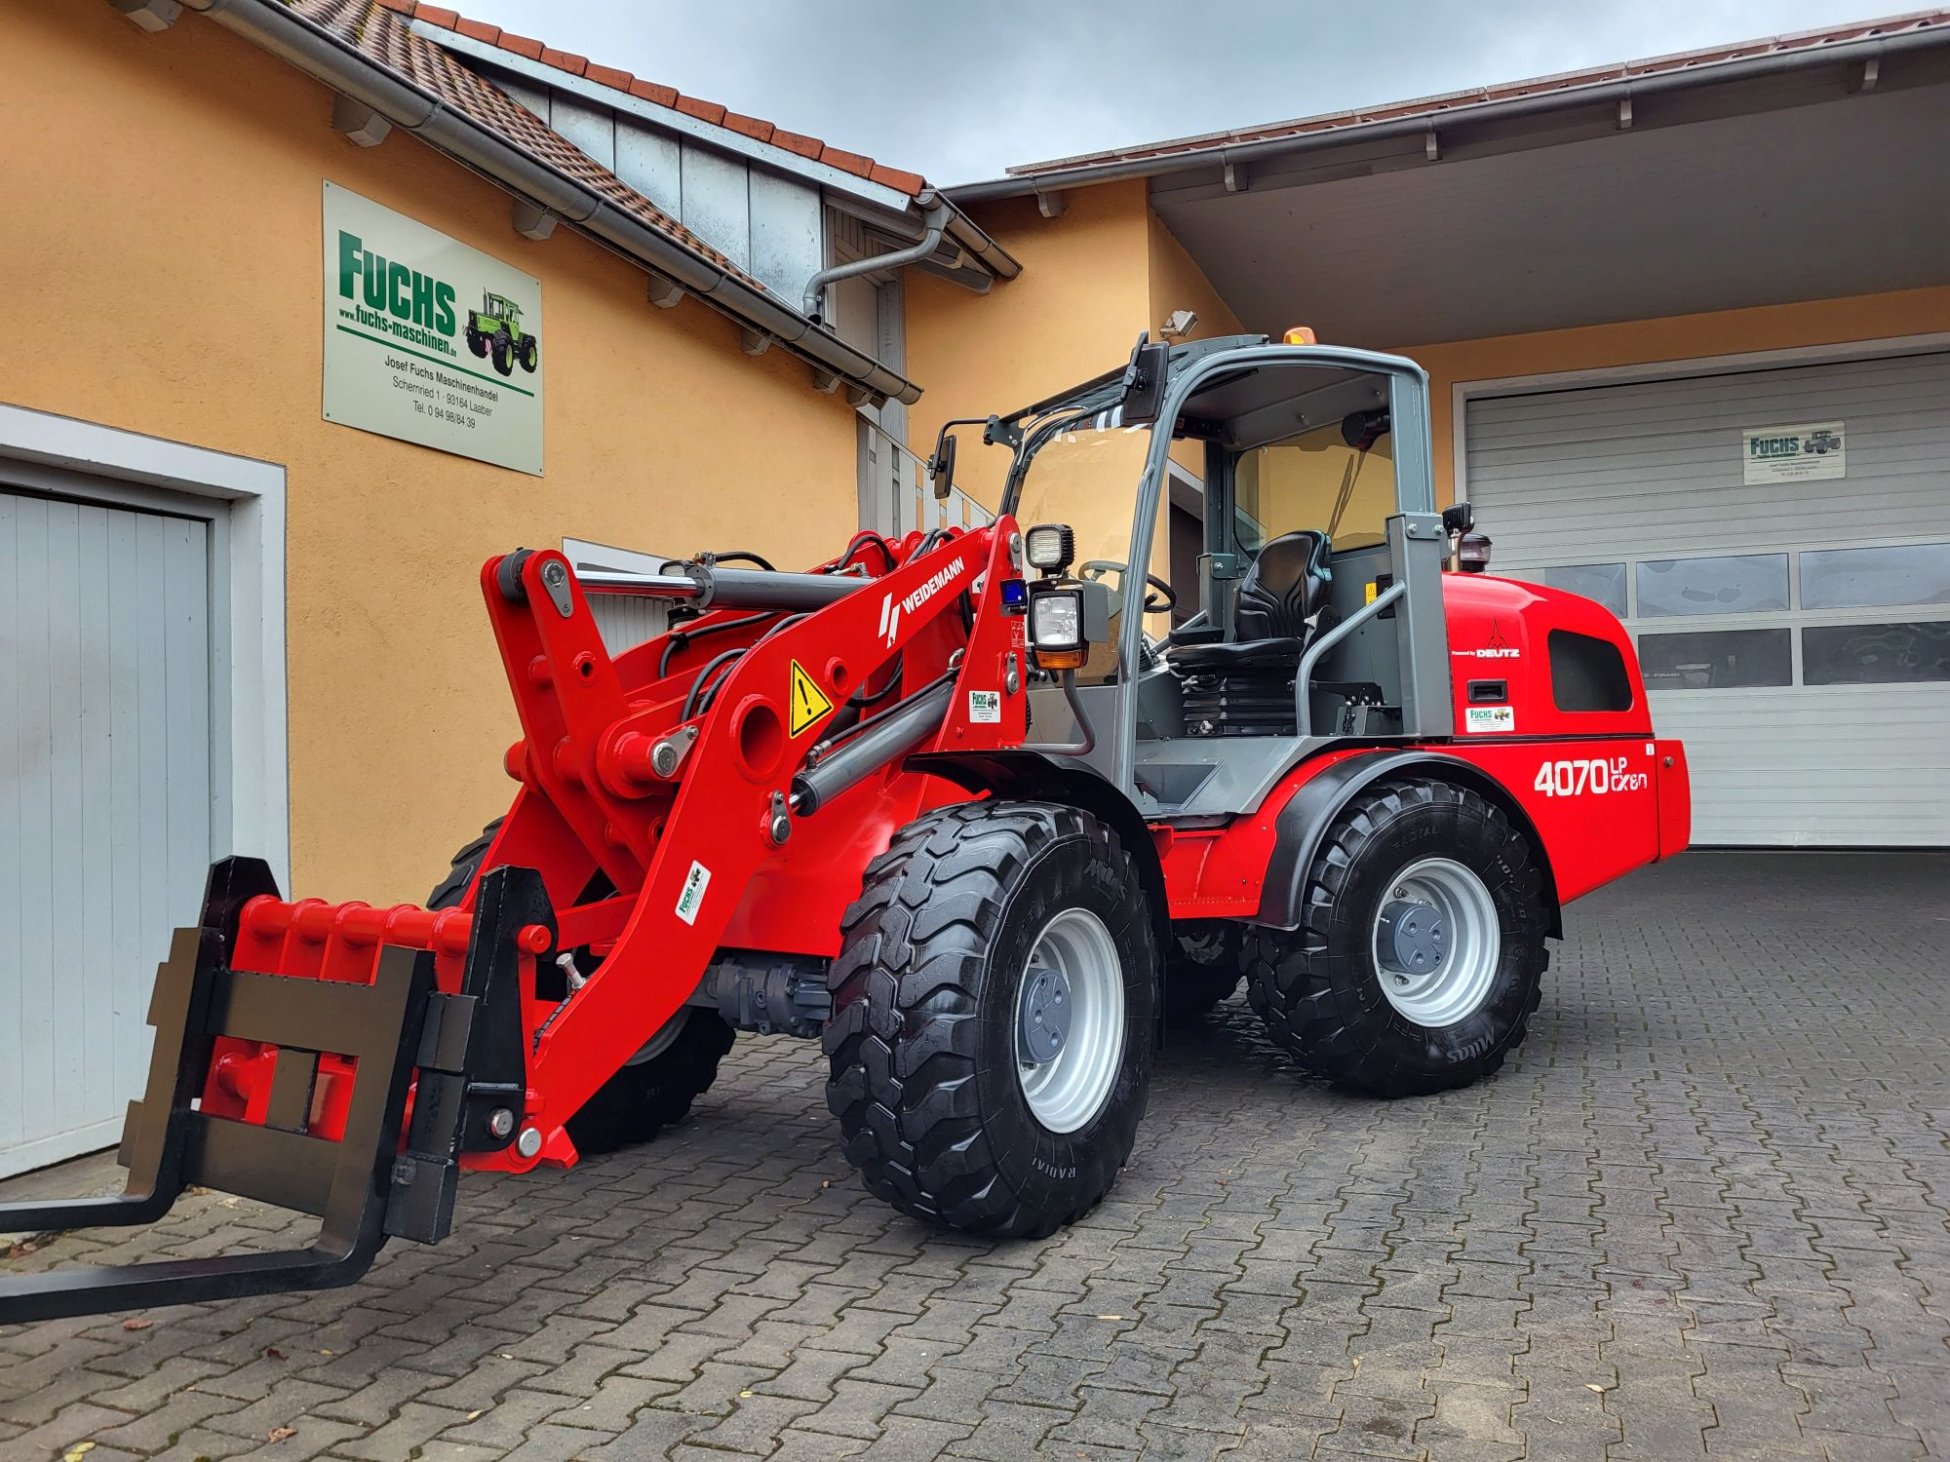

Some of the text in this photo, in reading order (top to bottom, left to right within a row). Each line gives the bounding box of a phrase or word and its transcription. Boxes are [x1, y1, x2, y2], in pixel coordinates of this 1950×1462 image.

[339, 229, 456, 338] FUCHS
[339, 304, 457, 357] www.fuchs-maschinen.de
[385, 355, 499, 402] Josef Fuchs Maschinenhandel
[392, 375, 434, 399] Schernried
[446, 393, 468, 410] 93164
[469, 400, 493, 417] Laaber
[413, 400, 426, 414] Tel.
[428, 405, 433, 416] 0
[434, 406, 444, 419] 94
[466, 416, 476, 429] 39
[1750, 436, 1799, 455] FUCHS
[901, 556, 964, 614] WEIDEMANN
[1476, 648, 1520, 658] DEUTZ
[1470, 709, 1493, 719] FUCHS
[1534, 757, 1627, 797] 4070 LP
